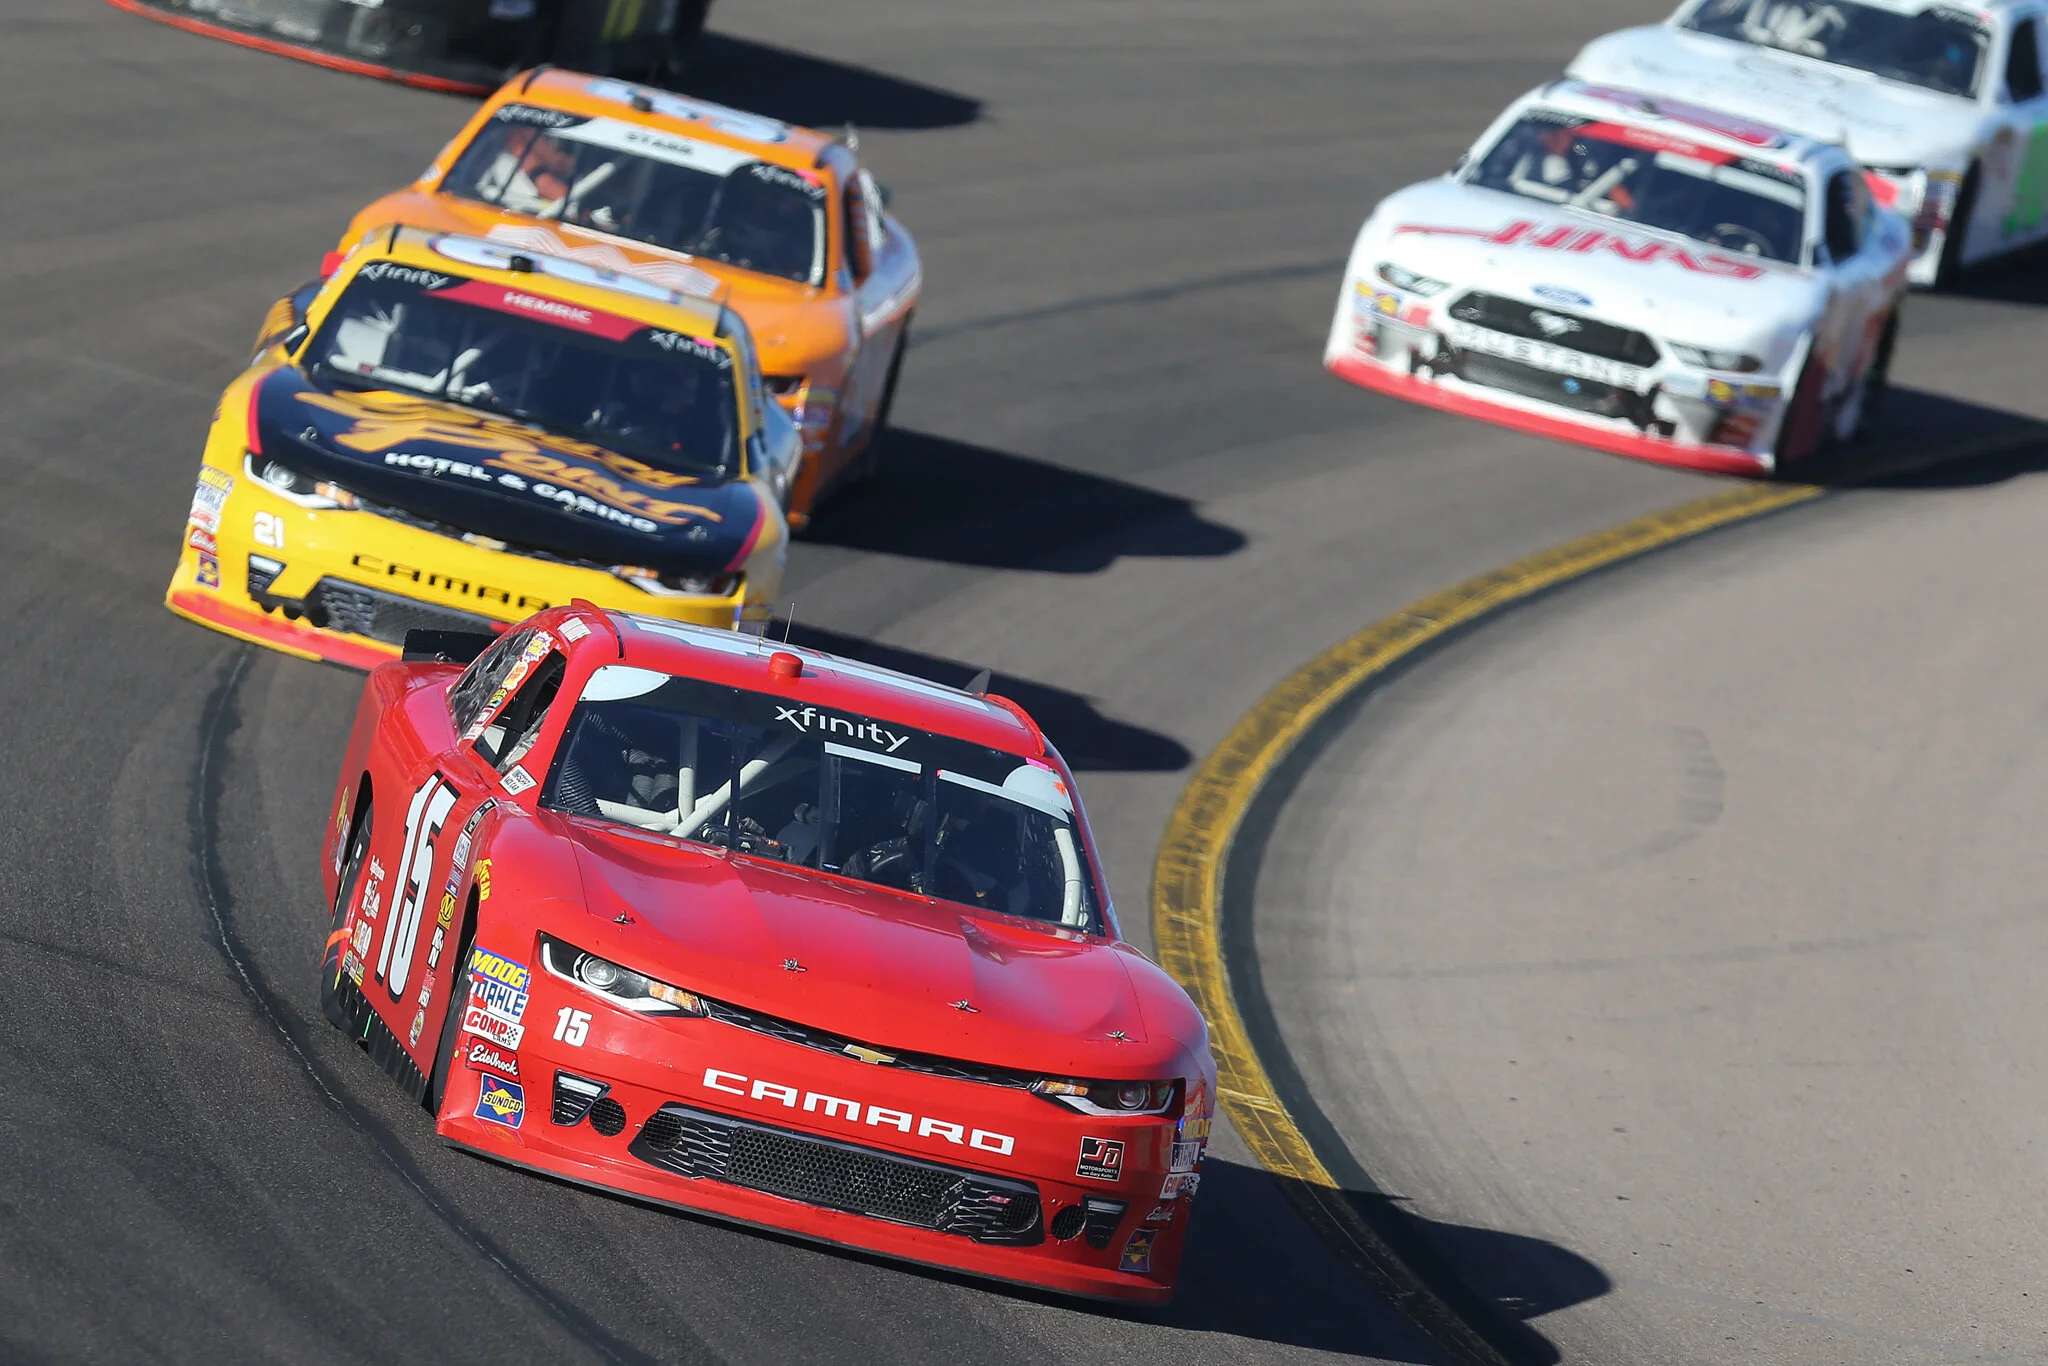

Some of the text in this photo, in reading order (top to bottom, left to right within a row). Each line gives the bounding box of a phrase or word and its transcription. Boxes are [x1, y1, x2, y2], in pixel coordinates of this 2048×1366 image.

[359, 262, 448, 289] xfinity
[503, 291, 593, 326] HEMRIC
[650, 329, 733, 371] xfinity
[384, 452, 658, 533] HOTEL & CASINO
[253, 510, 285, 550] 21
[352, 553, 550, 611] CAMAR
[775, 705, 909, 752] xfinity
[375, 771, 461, 1003] 15
[473, 949, 528, 989] MOOG
[466, 1011, 508, 1036] COMP
[492, 1034, 512, 1047] CAMS
[552, 1006, 593, 1048] 15
[469, 1044, 519, 1077] Edelbrock
[484, 1093, 522, 1113] SUNOCO
[703, 1068, 1015, 1156] CAMARO
[1079, 1164, 1118, 1175] MOTORSPORTS
